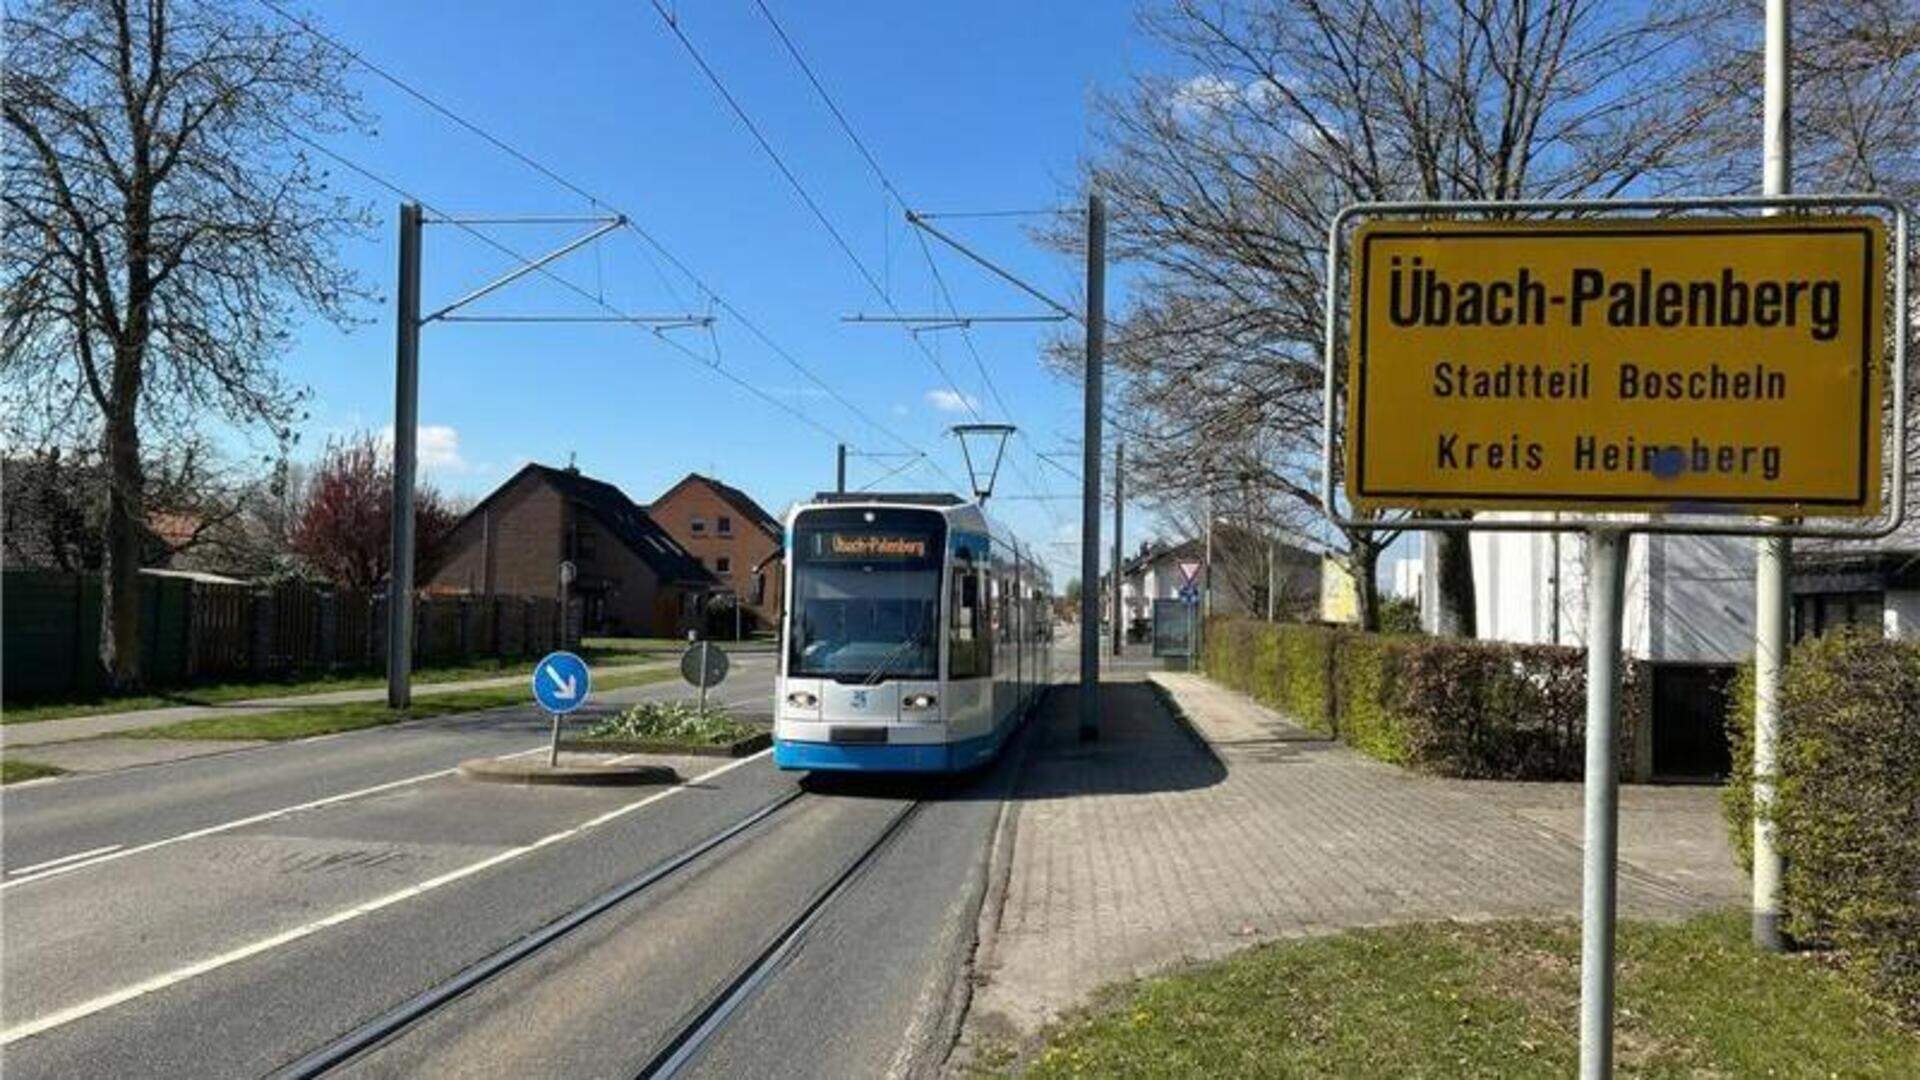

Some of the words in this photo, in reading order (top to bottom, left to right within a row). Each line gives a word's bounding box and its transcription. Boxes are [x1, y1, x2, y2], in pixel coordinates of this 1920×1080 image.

[1389, 257, 1840, 340] Übach-Palenberg
[1434, 362, 1590, 399] Stadtteil
[1619, 364, 1786, 400] Boscheln
[1437, 434, 1543, 471] Kreis
[1574, 435, 1781, 480] Heinberg
